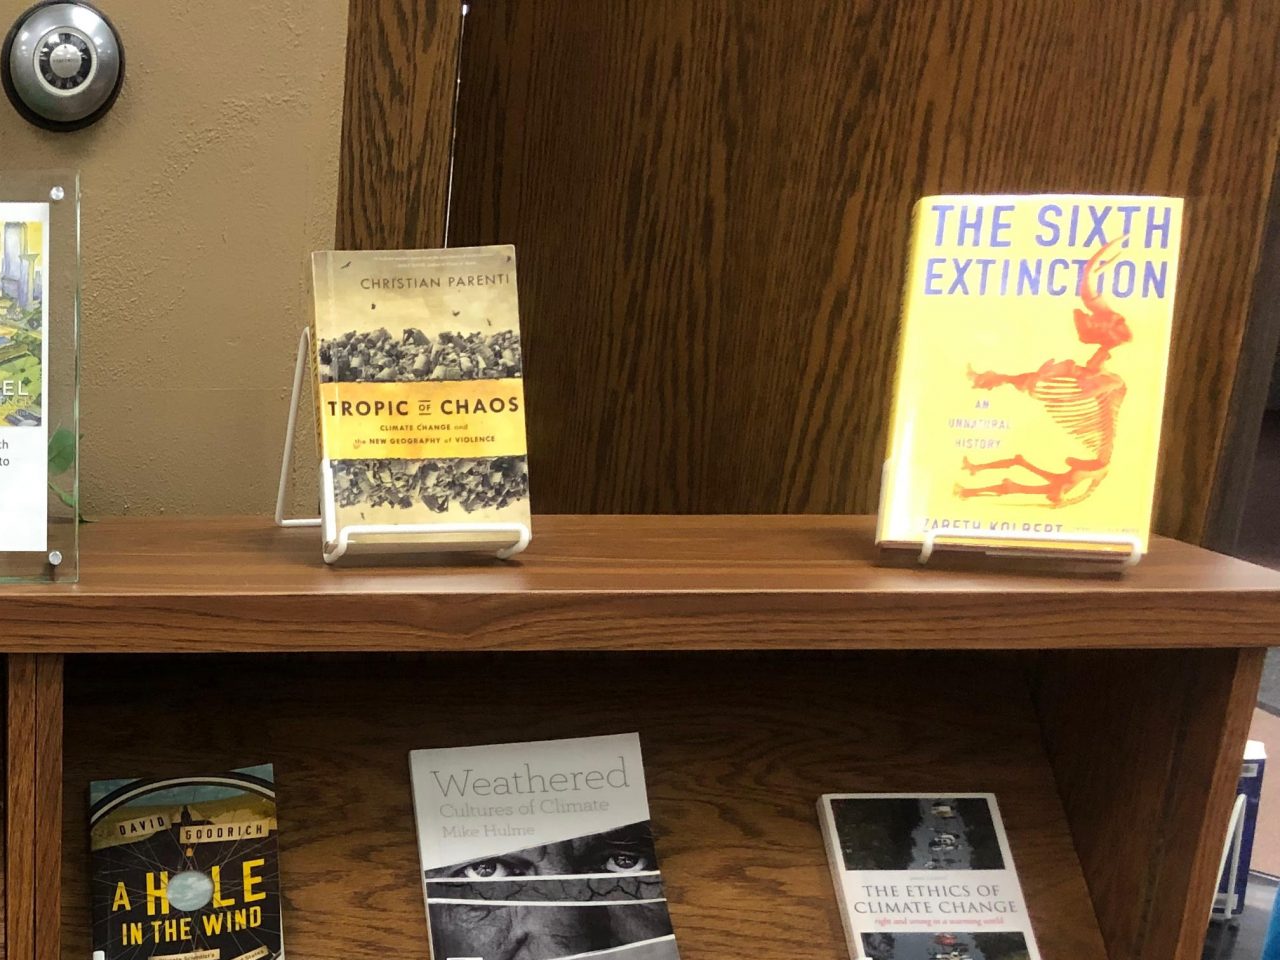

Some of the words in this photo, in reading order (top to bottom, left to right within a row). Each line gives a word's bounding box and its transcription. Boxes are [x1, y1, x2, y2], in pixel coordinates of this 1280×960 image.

[931, 205, 1016, 248] THE
[1035, 205, 1172, 249] SIXTH
[360, 276, 441, 290] CHRISTIAN
[448, 274, 510, 288] PARENTI
[924, 257, 1169, 299] EXTINCTION
[327, 400, 409, 417] TROPIC
[418, 403, 431, 412] OF
[441, 397, 519, 414] CHAOS
[379, 424, 414, 432] CLIMATE
[417, 423, 451, 431] CHANGE
[389, 437, 441, 445] GEOGRAPHY
[455, 436, 495, 444] VIOLENCE
[430, 756, 631, 798] Weathered
[439, 802, 514, 819] Cultures
[517, 799, 536, 815] of
[540, 798, 609, 815] Climate
[119, 816, 165, 836] DAVID
[185, 823, 263, 841] GOODRICH
[442, 824, 480, 839] Mike
[483, 823, 536, 838] Hulme
[111, 881, 131, 912] A
[145, 858, 267, 916] HOLE
[861, 885, 899, 897] THE
[907, 885, 970, 897] ETHICS
[976, 885, 1001, 897] OF
[854, 901, 933, 914] CLIMATE
[938, 900, 1018, 914] CHANGE
[122, 922, 143, 946] IN
[151, 917, 192, 944] THE
[202, 905, 263, 937] WIND
